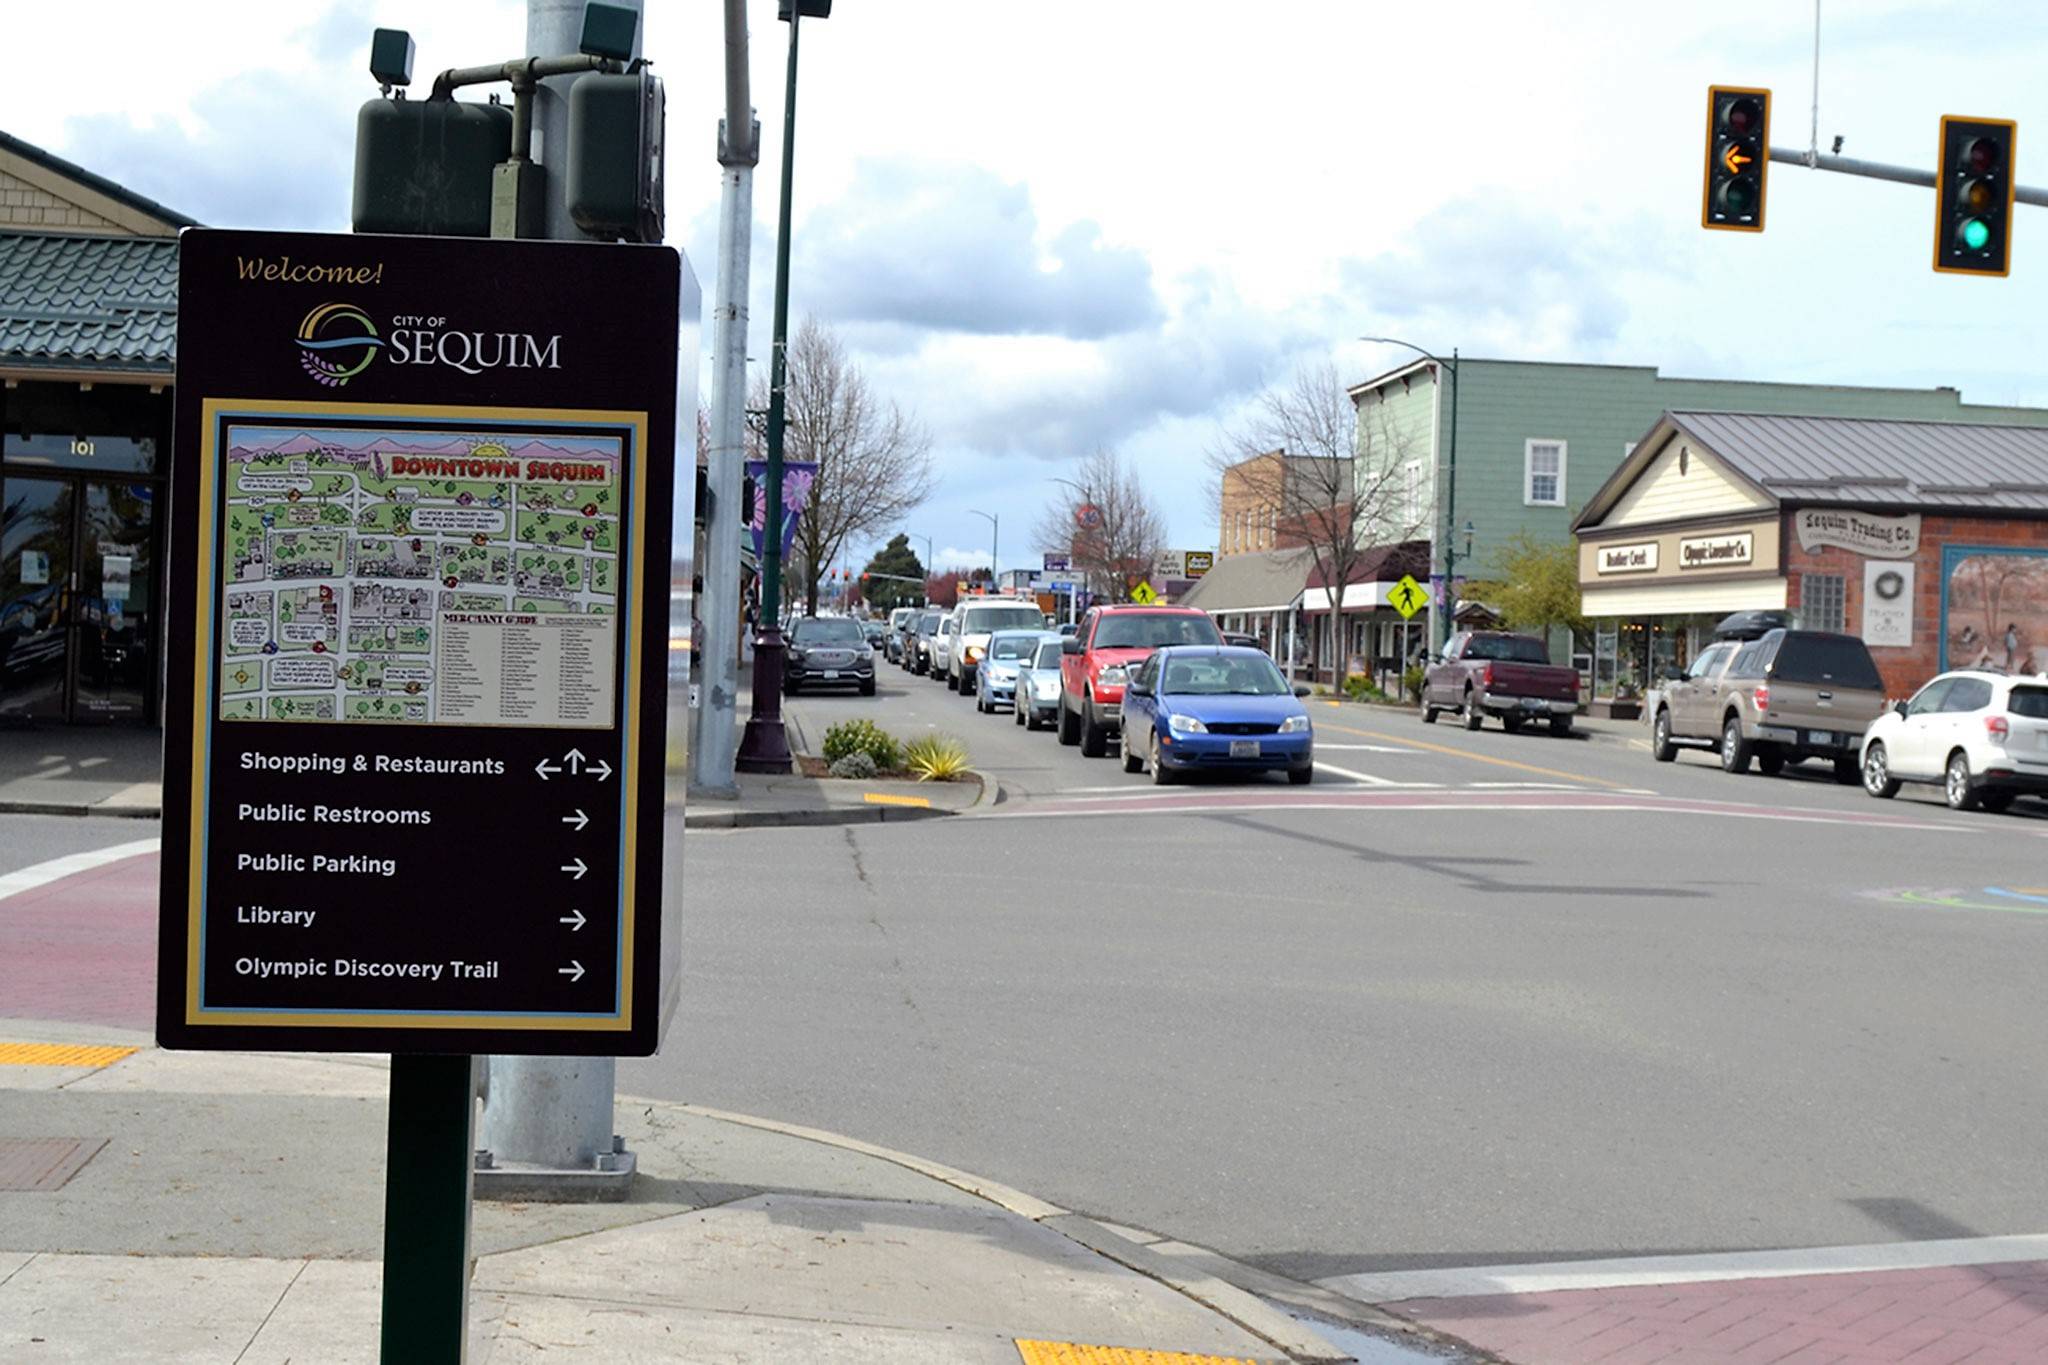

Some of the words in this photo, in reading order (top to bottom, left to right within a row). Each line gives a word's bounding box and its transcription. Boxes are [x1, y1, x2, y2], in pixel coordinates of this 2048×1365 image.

[236, 256, 383, 285] Welcome!
[392, 315, 424, 327] CITY
[428, 316, 446, 327] OF
[388, 330, 562, 375] SEQUIM
[70, 441, 94, 457] 101
[391, 456, 520, 479] DOWNTOWN
[526, 461, 606, 482] SEQUIM
[1805, 512, 1848, 531] Sequim
[1850, 518, 1893, 543] Trading
[1894, 526, 1914, 541] Co.
[240, 751, 347, 775] Shopping
[353, 755, 368, 773] &
[375, 755, 505, 775] Restaurants
[238, 803, 307, 824] Public
[313, 805, 431, 825] Restrooms
[238, 853, 305, 874] Public
[312, 855, 396, 877] Parking
[238, 906, 316, 928] Library
[235, 957, 327, 979] Olympic
[334, 958, 443, 980] Discovery
[450, 960, 499, 979] Trail
